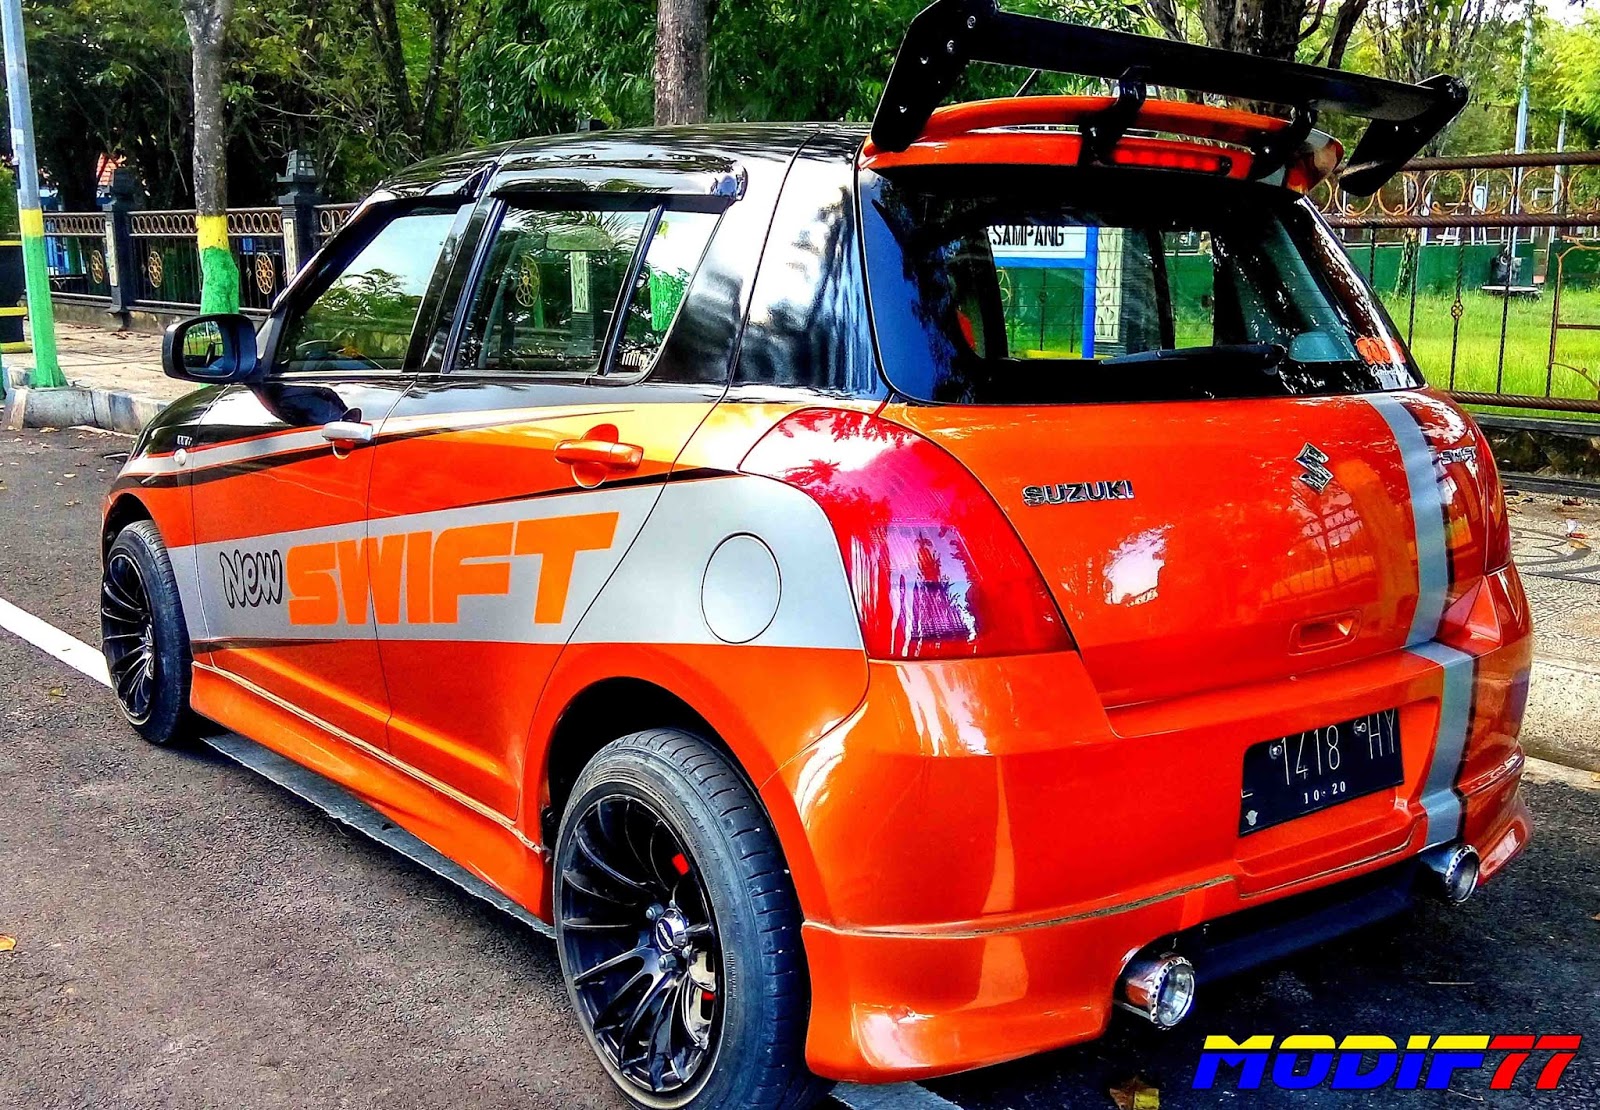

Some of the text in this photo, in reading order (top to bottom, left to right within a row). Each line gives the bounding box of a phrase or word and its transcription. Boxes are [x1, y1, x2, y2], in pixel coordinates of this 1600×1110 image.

[992, 225, 1065, 247] SAMPANG
[1022, 480, 1135, 506] SUZUKI
[286, 511, 619, 625] SWIFT
[1281, 724, 1341, 786] 1418
[1367, 708, 1396, 760] HY
